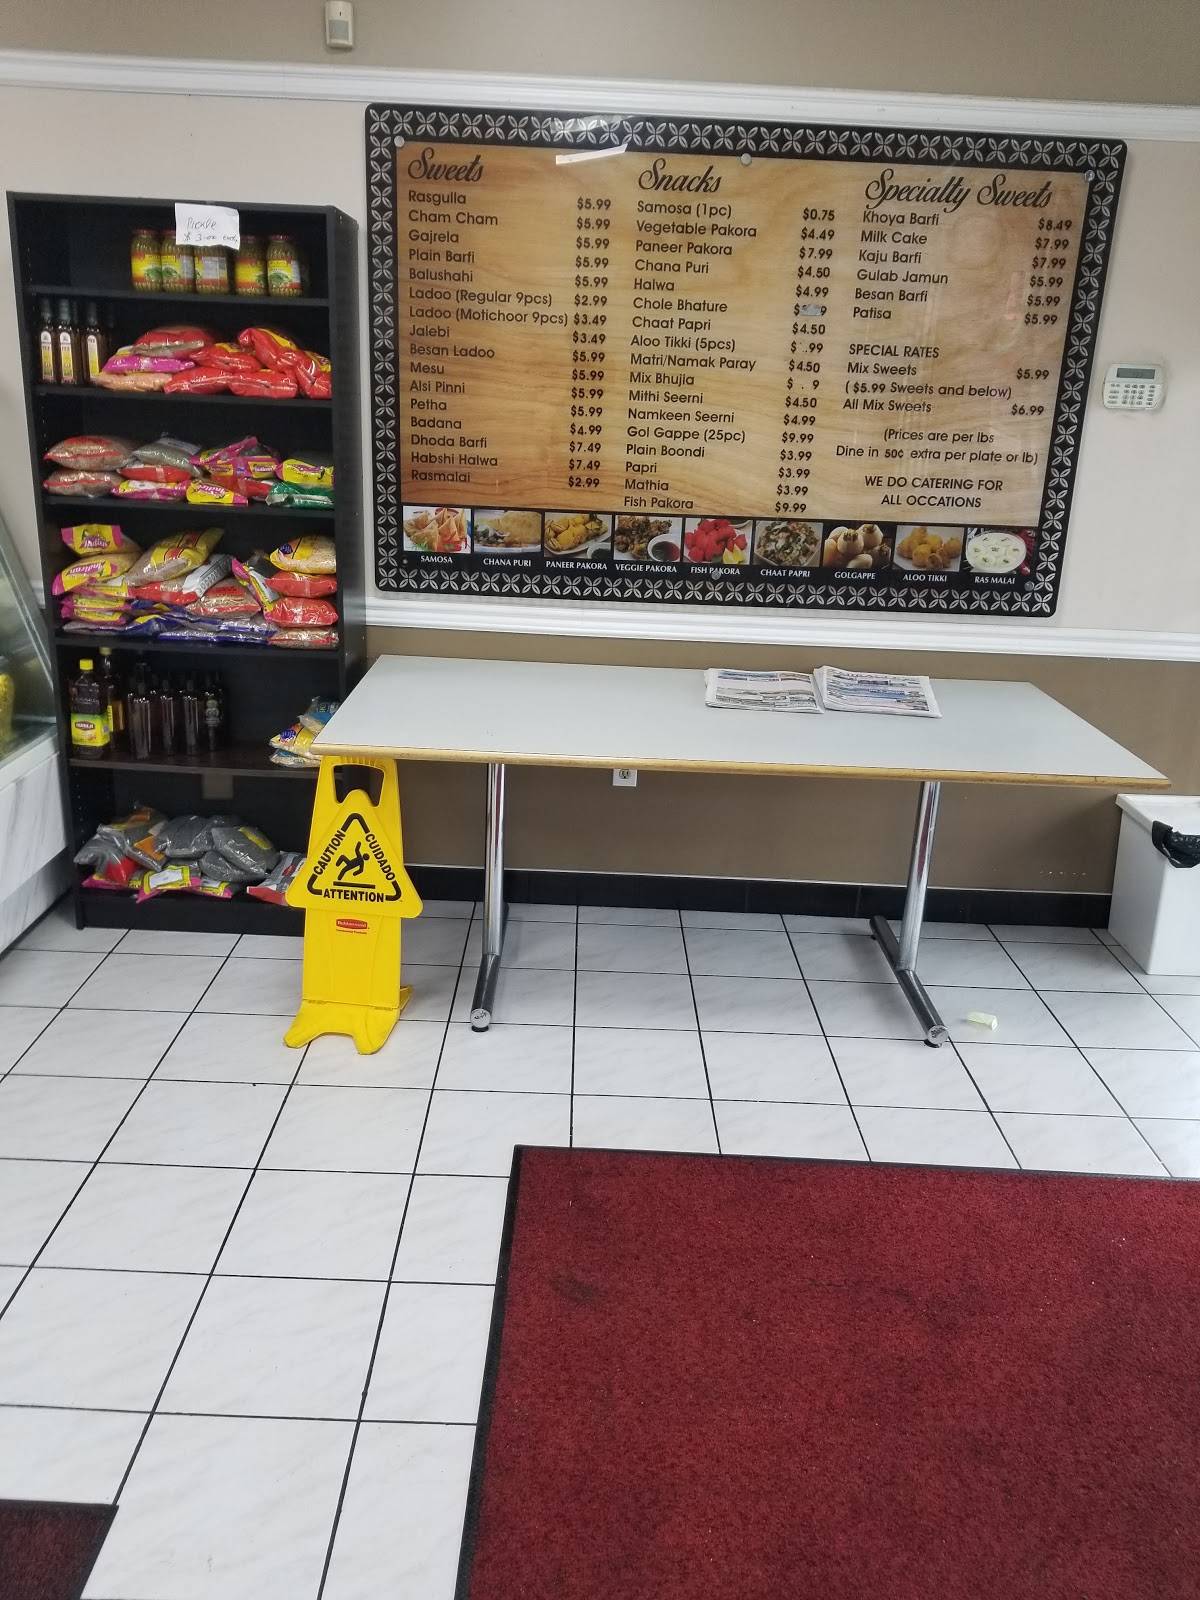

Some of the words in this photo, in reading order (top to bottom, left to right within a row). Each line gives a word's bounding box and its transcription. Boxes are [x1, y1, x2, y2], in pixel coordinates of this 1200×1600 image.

[408, 147, 484, 182] Sweets
[638, 158, 721, 193] Snacks
[409, 190, 466, 206] Rasgulla
[578, 196, 611, 210] $5.99
[865, 169, 971, 213] Specialty
[977, 174, 1052, 208] Sweets
[409, 209, 451, 223] Cham
[456, 212, 498, 225] Cham
[577, 216, 610, 230] $5.99
[638, 200, 691, 214] Samosa
[697, 203, 731, 219] (1pc)
[803, 208, 835, 221] $0.75
[637, 220, 706, 236] Vegetable
[711, 224, 756, 237] Pakora
[801, 226, 834, 240] $4.49
[863, 211, 905, 226] Khoya
[910, 213, 939, 225] Barfi
[1038, 217, 1072, 231] $8.49
[409, 229, 459, 244] Gajrela
[861, 230, 887, 242] Milk
[892, 232, 927, 244] Cake
[1035, 237, 1069, 250] $7.99
[409, 248, 440, 261] Plain
[446, 250, 474, 263] Barfi
[636, 240, 683, 253] Paneer
[687, 242, 732, 255] Pakora
[799, 246, 832, 259] $7.99
[859, 249, 887, 264] Kaju
[893, 251, 921, 263] Barfi
[1032, 256, 1066, 269] $7.99
[410, 268, 472, 282] Balushahi
[635, 259, 680, 272] Chana
[686, 261, 708, 273] Puri
[798, 265, 830, 279] $4.50
[857, 269, 898, 281] Gulab
[902, 271, 948, 284] Jamun
[634, 278, 674, 291] Halwa
[796, 284, 828, 298] $4.99
[855, 288, 894, 300] Besan
[899, 290, 928, 302] Barfi
[409, 287, 451, 300] Ladoo
[456, 290, 512, 304] (Regular
[516, 292, 552, 308] 9pcs)
[574, 294, 607, 307] $2.99
[633, 297, 673, 310] Chole
[677, 299, 727, 312] Bhature
[410, 306, 451, 319] Ladoo
[456, 308, 528, 322] (Motichoor
[532, 312, 568, 327] 9pcs)
[574, 313, 606, 326] $3.49
[632, 316, 674, 328] Chaat
[678, 318, 710, 332] Papri
[792, 322, 825, 335] $4.50
[853, 307, 891, 319] Patisa
[1024, 312, 1057, 326] $5.99
[410, 325, 449, 338] Jalebi
[573, 331, 606, 344] $3.49
[631, 335, 660, 347] Aloo
[665, 336, 691, 348] Tikki
[696, 338, 735, 352] (5pcs)
[410, 343, 449, 356] Besan
[453, 345, 495, 358] Ladoo
[849, 344, 899, 356] SPECIAL
[904, 346, 939, 358] RATES
[410, 362, 444, 375] Mesu
[631, 353, 715, 367] Matri/Namak
[720, 357, 756, 372] Paray
[789, 359, 820, 373] $4.50
[848, 362, 869, 373] Mix
[873, 363, 916, 375] Sweets
[409, 380, 430, 392] Alsi
[436, 381, 465, 393] Pinni
[630, 372, 652, 383] Mix
[656, 373, 694, 387] Bhujia
[629, 390, 659, 402] Mithi
[664, 392, 703, 403] Seerni
[785, 396, 817, 408] $4.50
[853, 382, 885, 394] $5.99
[890, 382, 933, 394] Sweets
[938, 385, 964, 395] and
[968, 385, 1011, 400] below)
[411, 398, 447, 410] Petha
[571, 405, 602, 417] $5.99
[843, 399, 858, 409] All
[863, 399, 884, 410] Mix
[888, 400, 931, 413] Sweets
[1011, 403, 1044, 415] $6.99
[411, 416, 461, 429] Badana
[570, 422, 602, 435] $4.99
[629, 408, 690, 421] Namkeen
[695, 411, 734, 423] Seerni
[784, 414, 815, 425] $4.99
[411, 434, 454, 446] Dhoda
[460, 437, 486, 448] Barfi
[570, 441, 601, 453] $7.49
[627, 426, 649, 437] Gol
[654, 427, 699, 441] Gappe
[704, 429, 745, 443] (25pc)
[782, 431, 814, 443] $9.99
[884, 428, 923, 442] (Prices
[928, 433, 948, 441] are
[952, 433, 973, 444] per
[977, 432, 994, 443] lbs
[627, 444, 656, 455] Plain
[661, 445, 704, 457] Boondi
[836, 445, 864, 456] Dine
[869, 446, 878, 457] in
[911, 449, 941, 459] extra
[945, 452, 966, 461] per
[970, 450, 1002, 463] plate
[1006, 454, 1019, 462] or
[1022, 452, 1037, 465] lb)
[411, 451, 454, 464] Habshi
[459, 454, 497, 466] Halwa
[569, 459, 600, 471] $7.49
[626, 461, 656, 475] Papri
[412, 470, 470, 482] Rasmalai
[568, 476, 599, 487] $2.99
[625, 479, 668, 490] Mathia
[777, 484, 808, 496] $3.99
[865, 476, 883, 486] WE
[887, 477, 907, 487] DO
[912, 477, 973, 490] CATERING
[978, 480, 1003, 491] FOR
[624, 496, 646, 507] Fish
[651, 497, 693, 509] Pakora
[775, 501, 806, 513] $9.99
[881, 495, 901, 505] ALL
[907, 495, 981, 507] OCCATIONS
[313, 830, 346, 875] CAUTION
[365, 833, 395, 881] CUIDADO
[323, 889, 384, 903] ATTENTION
